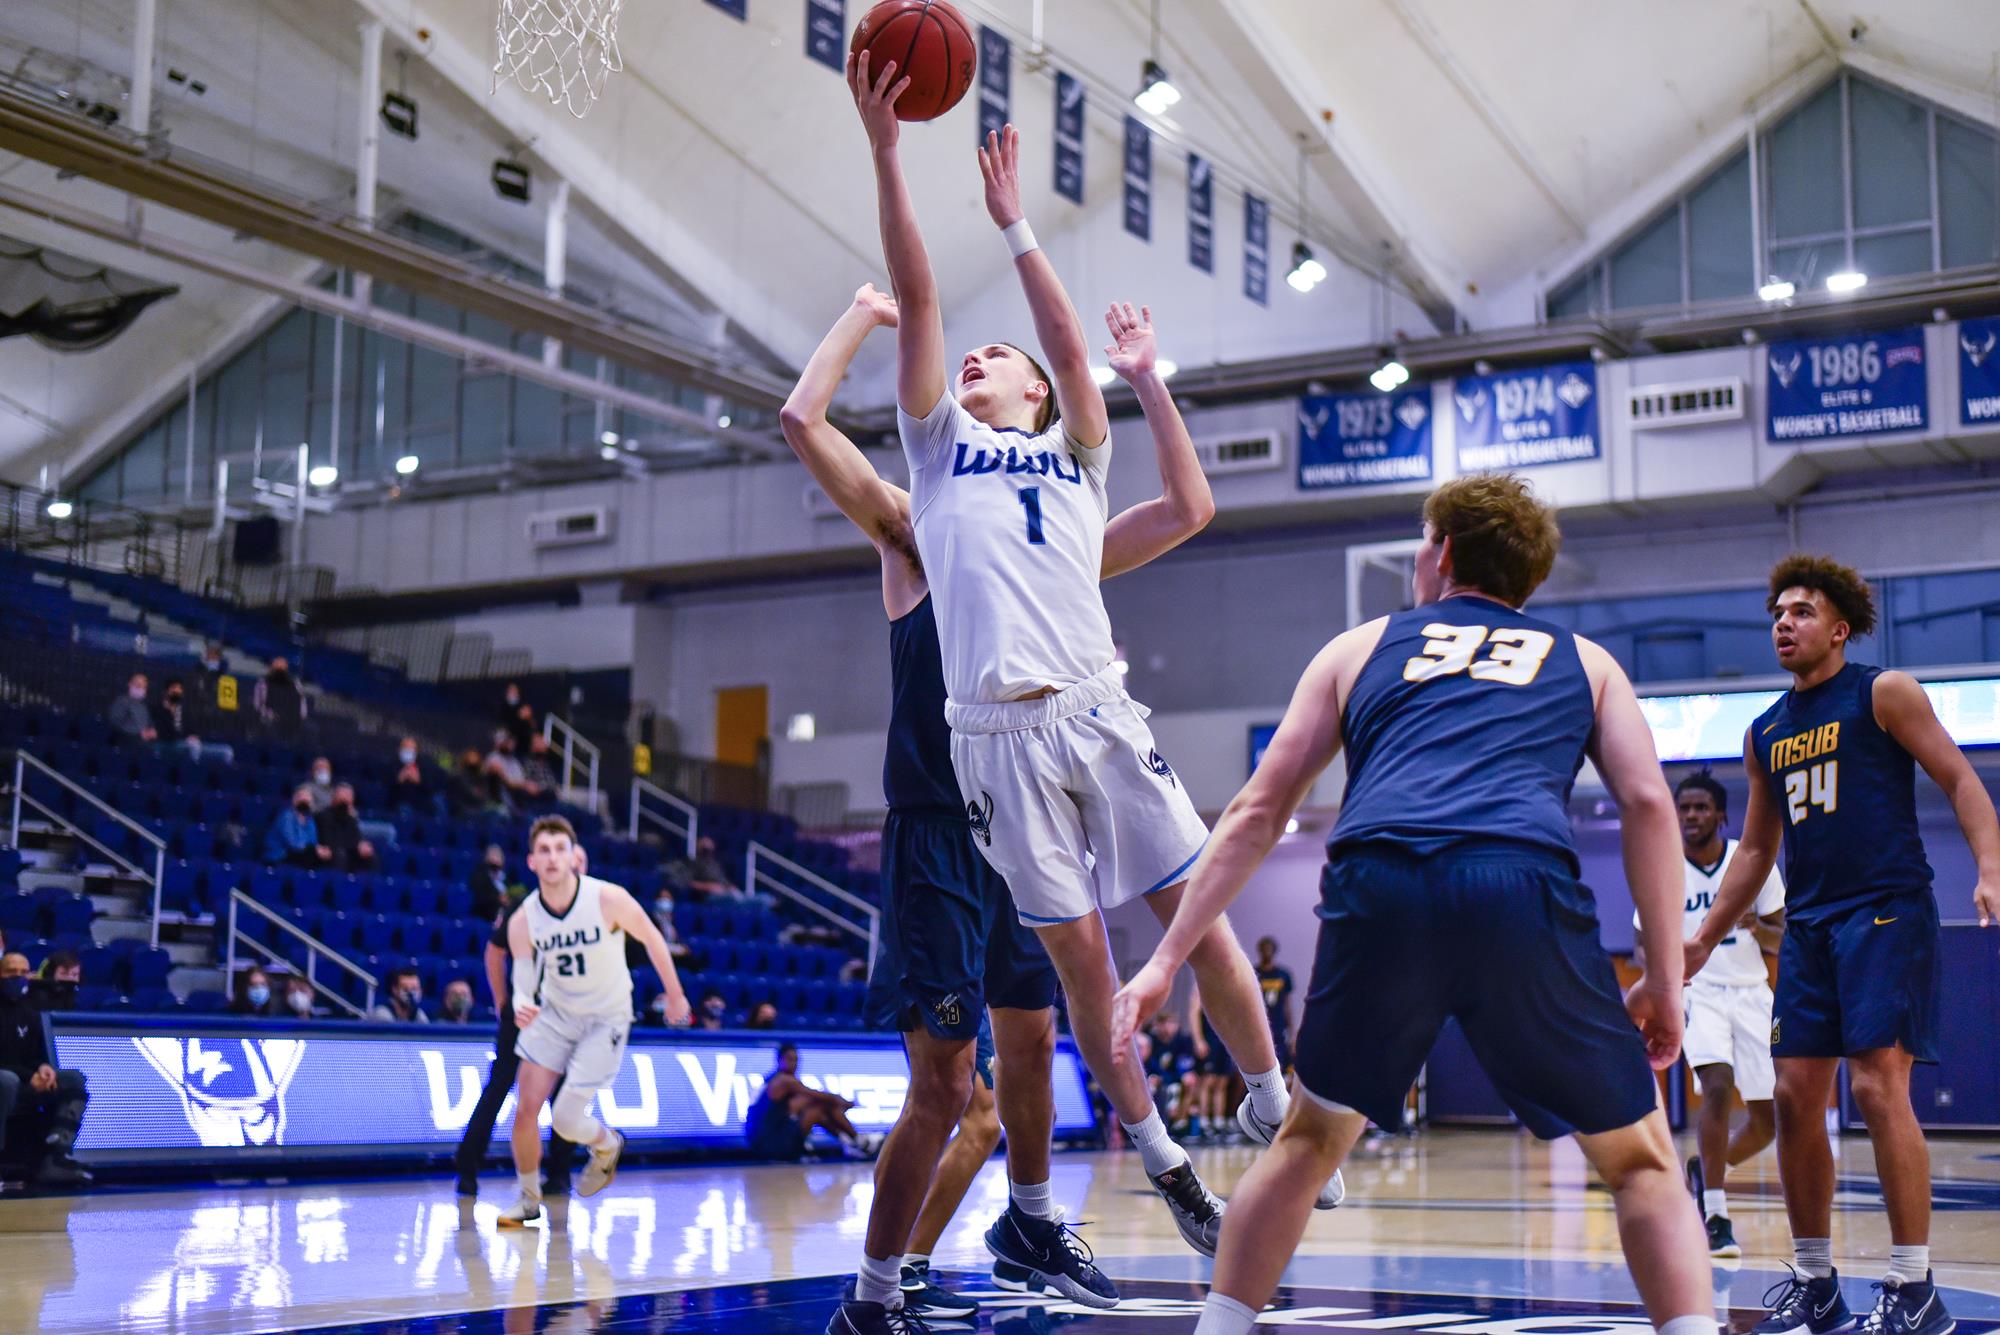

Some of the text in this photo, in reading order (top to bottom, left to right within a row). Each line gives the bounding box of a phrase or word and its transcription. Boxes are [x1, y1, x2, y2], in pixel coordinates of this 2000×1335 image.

[1808, 341, 1881, 387] 1986
[1492, 375, 1555, 420] 1974
[1773, 405, 1921, 438] WOMEN'S BASKETBALL
[952, 443, 1081, 485] WWU
[1018, 486, 1046, 545] 1
[1403, 623, 1555, 685] 33
[1771, 721, 1840, 774] MSUB
[1785, 760, 1838, 826] 24
[536, 926, 600, 951] WWU
[556, 953, 586, 976] 21
